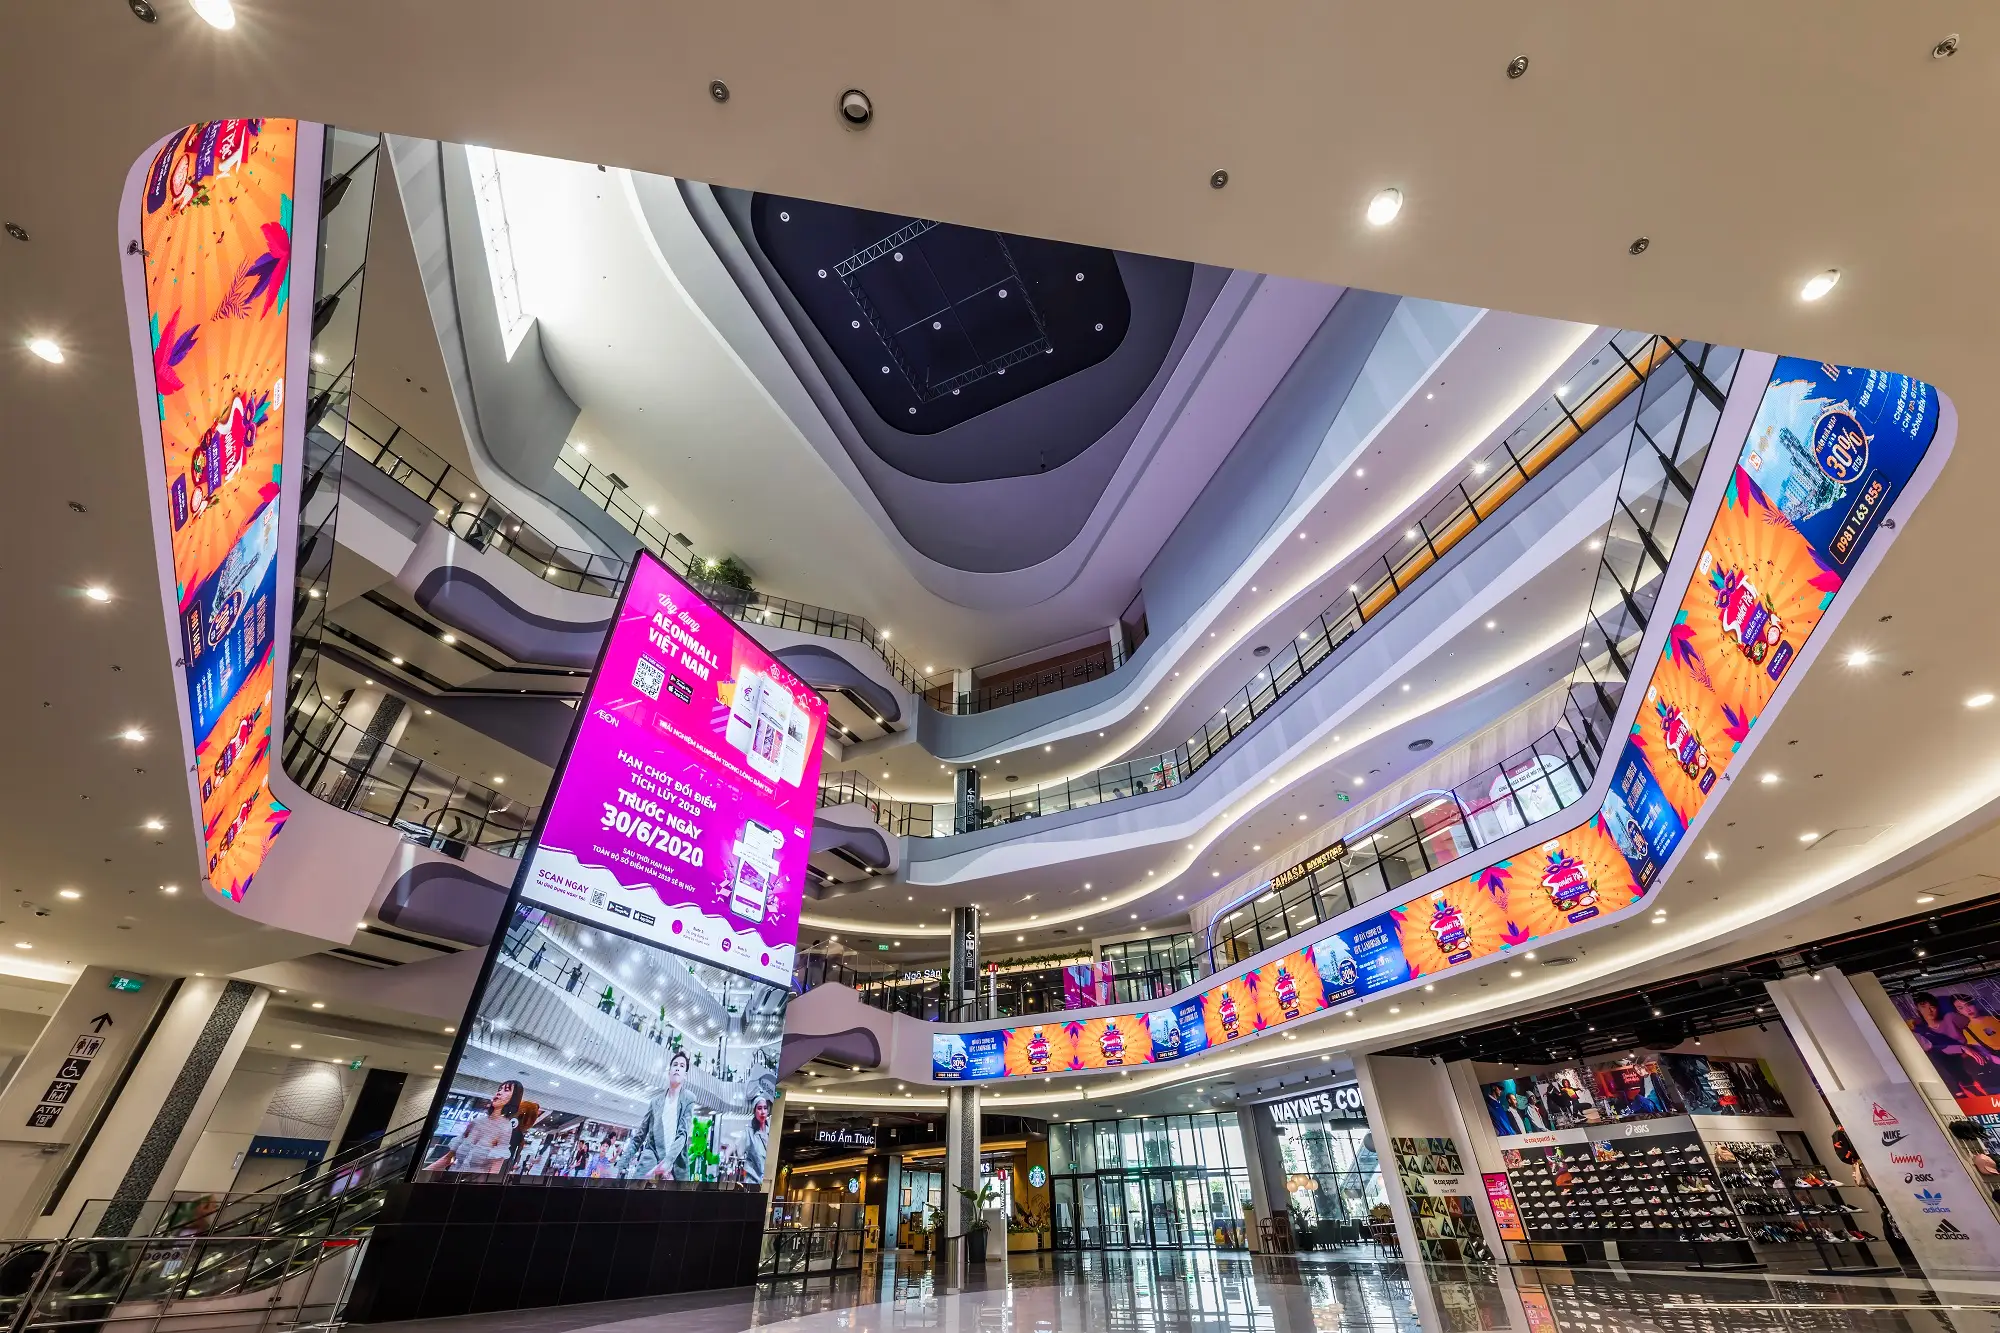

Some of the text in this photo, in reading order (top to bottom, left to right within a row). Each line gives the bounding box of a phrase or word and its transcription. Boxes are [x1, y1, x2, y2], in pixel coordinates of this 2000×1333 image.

[1894, 398, 1906, 420] CHIẾT
[1902, 410, 1912, 428] CHỈ
[1827, 427, 1862, 478] 30%
[1836, 480, 1882, 552] 0981 163 855
[678, 612, 700, 632] dụng
[649, 627, 710, 682] VIỆT NAM
[652, 612, 718, 670] AEONMALL
[673, 728, 696, 746] NGHIỆM
[722, 758, 740, 774] TRONG
[618, 750, 643, 770] HẠN
[674, 780, 692, 798] ĐỔI
[694, 792, 717, 811] ĐIỂM
[631, 772, 700, 816] TÍCH LŨY 2019
[618, 788, 703, 840] TRƯỚC NGÀY
[600, 802, 704, 868] 30/6/2020
[592, 845, 610, 856] TOÀN
[610, 851, 620, 862] BỘ
[620, 854, 629, 865] SỐ
[630, 860, 644, 871] ĐIỂM
[644, 866, 658, 877] NĂM
[622, 848, 636, 857] SAU
[664, 862, 674, 874] NÀY
[1271, 844, 1343, 890] FAHASA BOOKSTORE
[538, 869, 589, 894] SCAN NGAY
[36, 1106, 61, 1115] ATM
[1269, 1093, 1332, 1122] WAYNE'S
[820, 1128, 874, 1146] Phố Ẩm Thực
[1634, 1124, 1649, 1134] asics
[1882, 1130, 1901, 1140] NIKE
[1915, 1174, 1934, 1182] asics
